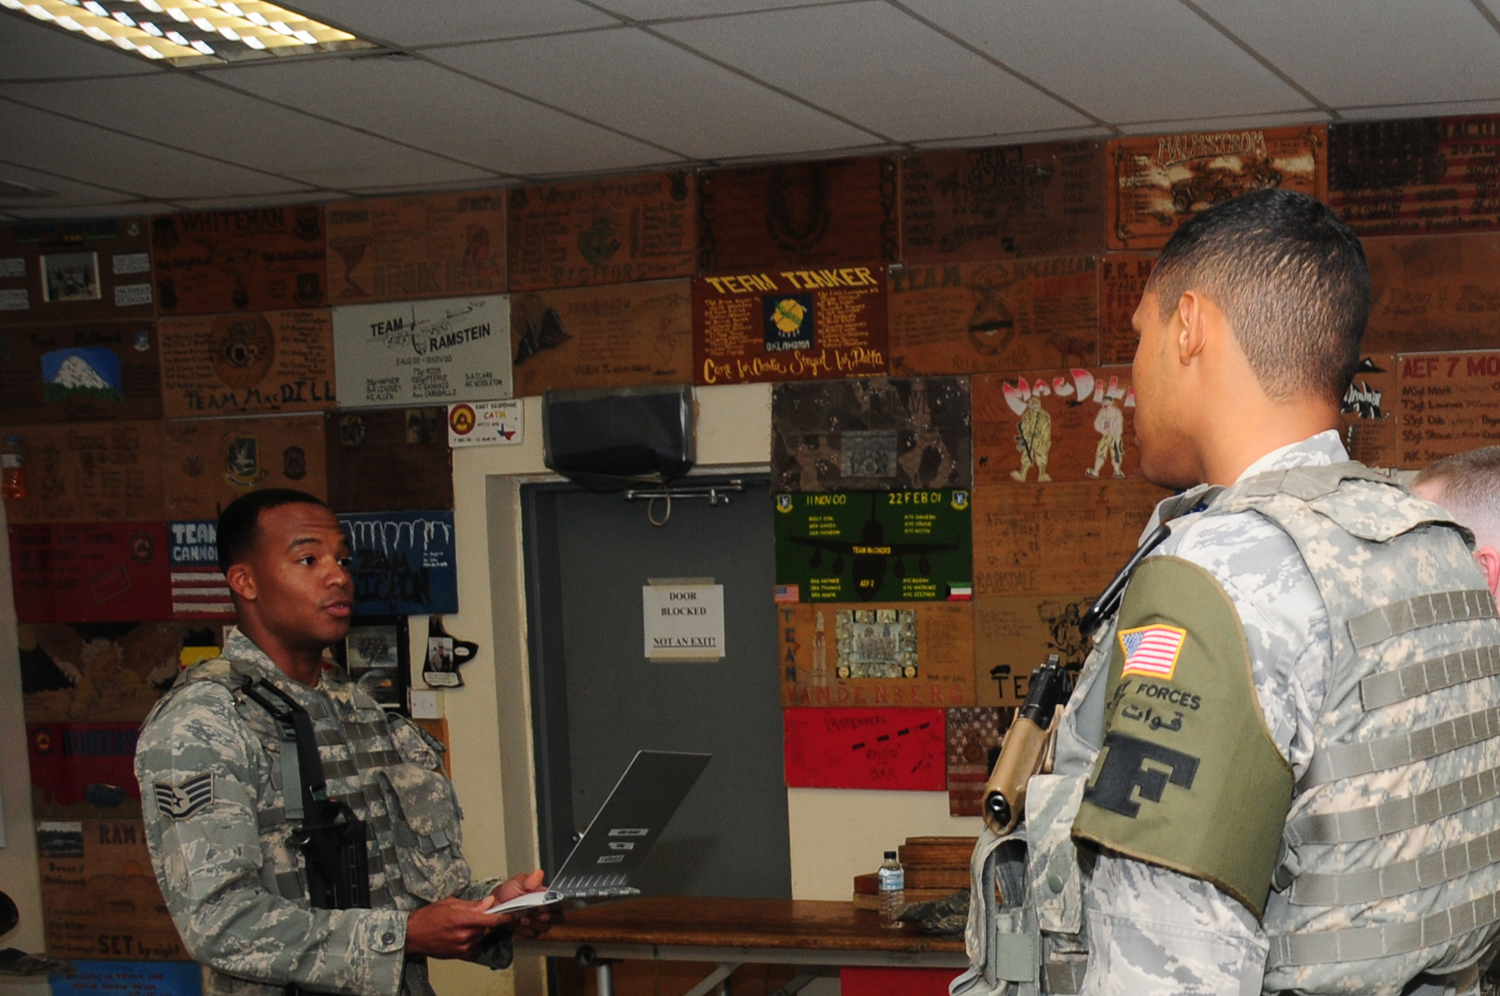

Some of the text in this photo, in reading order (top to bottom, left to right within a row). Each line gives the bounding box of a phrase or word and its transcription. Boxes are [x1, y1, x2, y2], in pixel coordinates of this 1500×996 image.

[180, 208, 284, 233] WHITEMAN
[704, 267, 878, 294] TEAM TINKER
[370, 318, 491, 352] TEAM RAMSTEIN
[766, 339, 811, 351] OKLAHOMA
[1402, 358, 1439, 379] AEF
[1447, 357, 1460, 377] 7
[184, 389, 238, 410] TEAM
[905, 493, 928, 504] FEB
[172, 546, 218, 563] CANNO
[669, 592, 697, 600] DOOR
[661, 607, 707, 616] BLOCKED
[653, 637, 716, 646] NOT AN EXIT!
[786, 683, 965, 704] VANDENBERG
[1135, 682, 1203, 711] FORCES
[98, 935, 133, 955] SET
